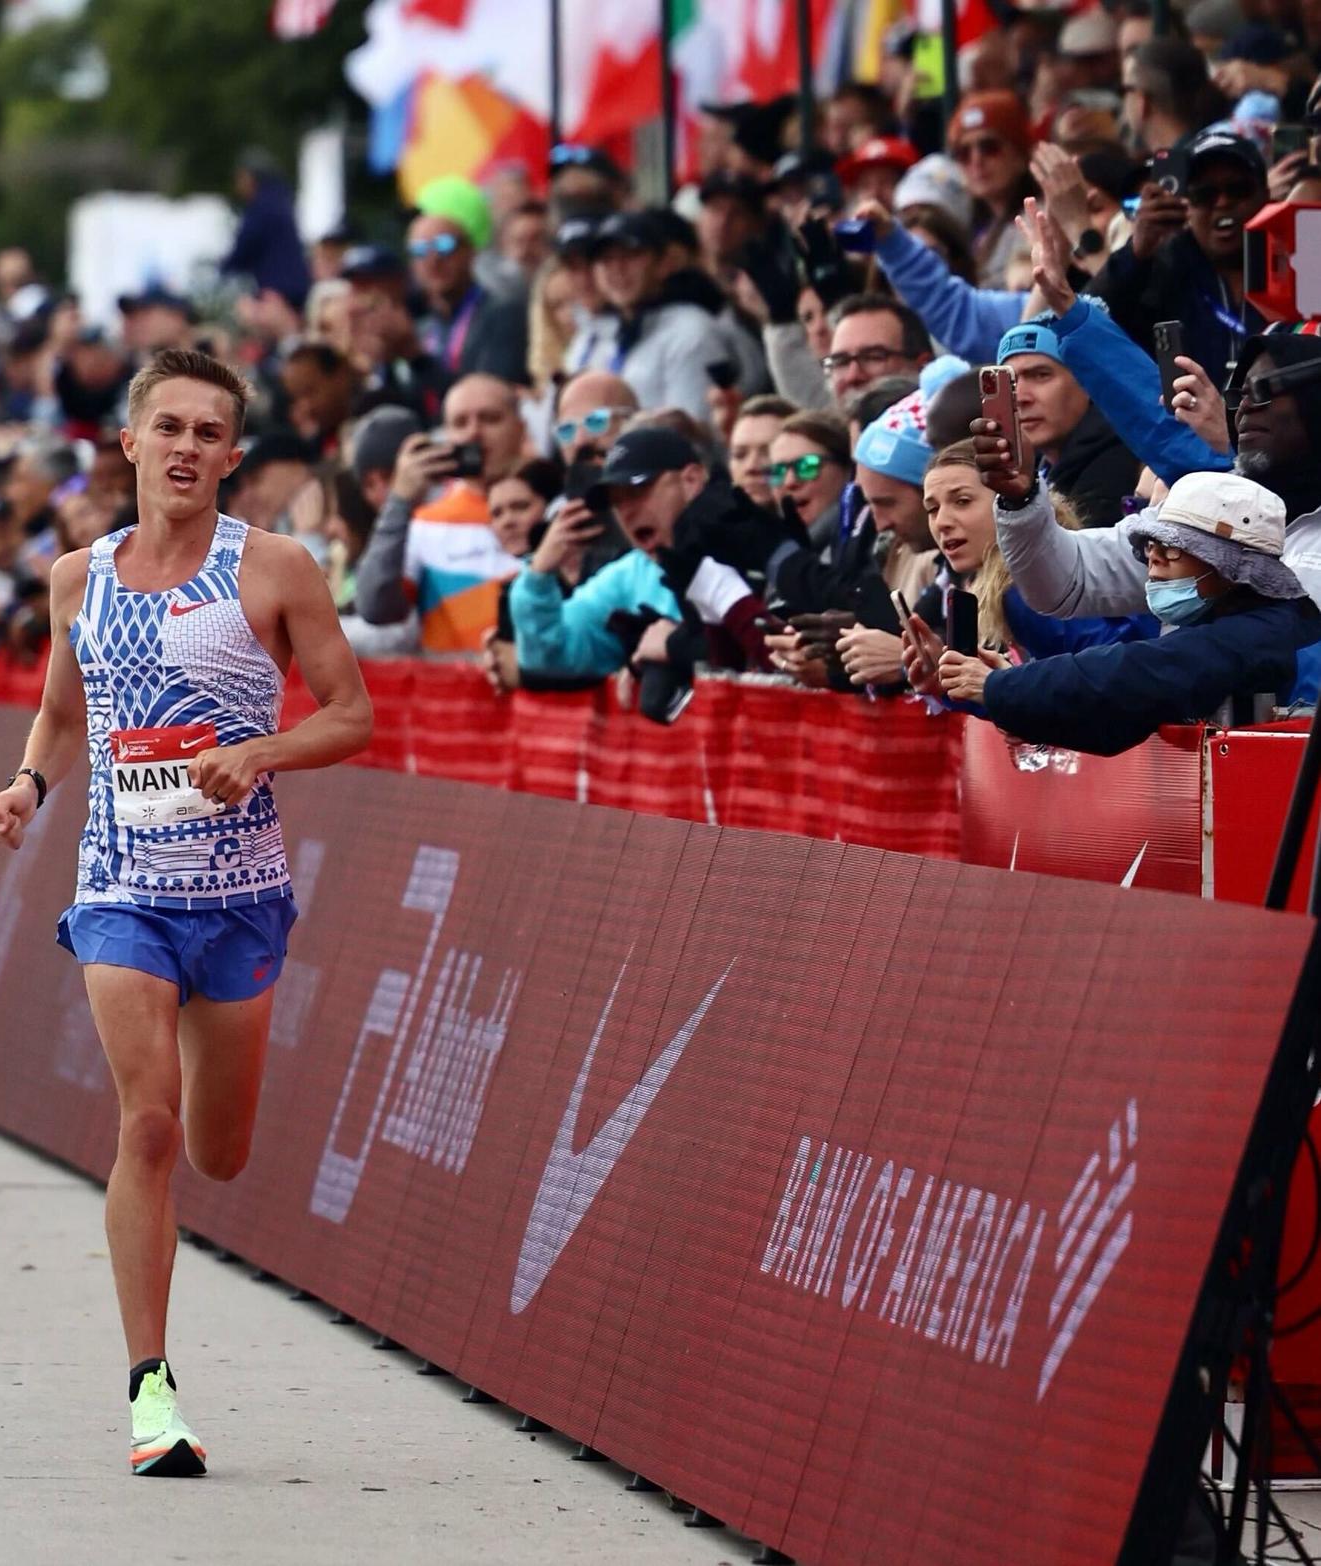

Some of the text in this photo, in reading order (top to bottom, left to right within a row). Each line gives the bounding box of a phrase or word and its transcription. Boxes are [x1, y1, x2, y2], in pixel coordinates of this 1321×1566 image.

[382, 947, 522, 1175] Abbott
[759, 1135, 1047, 1369] BANK OF AMERICA
